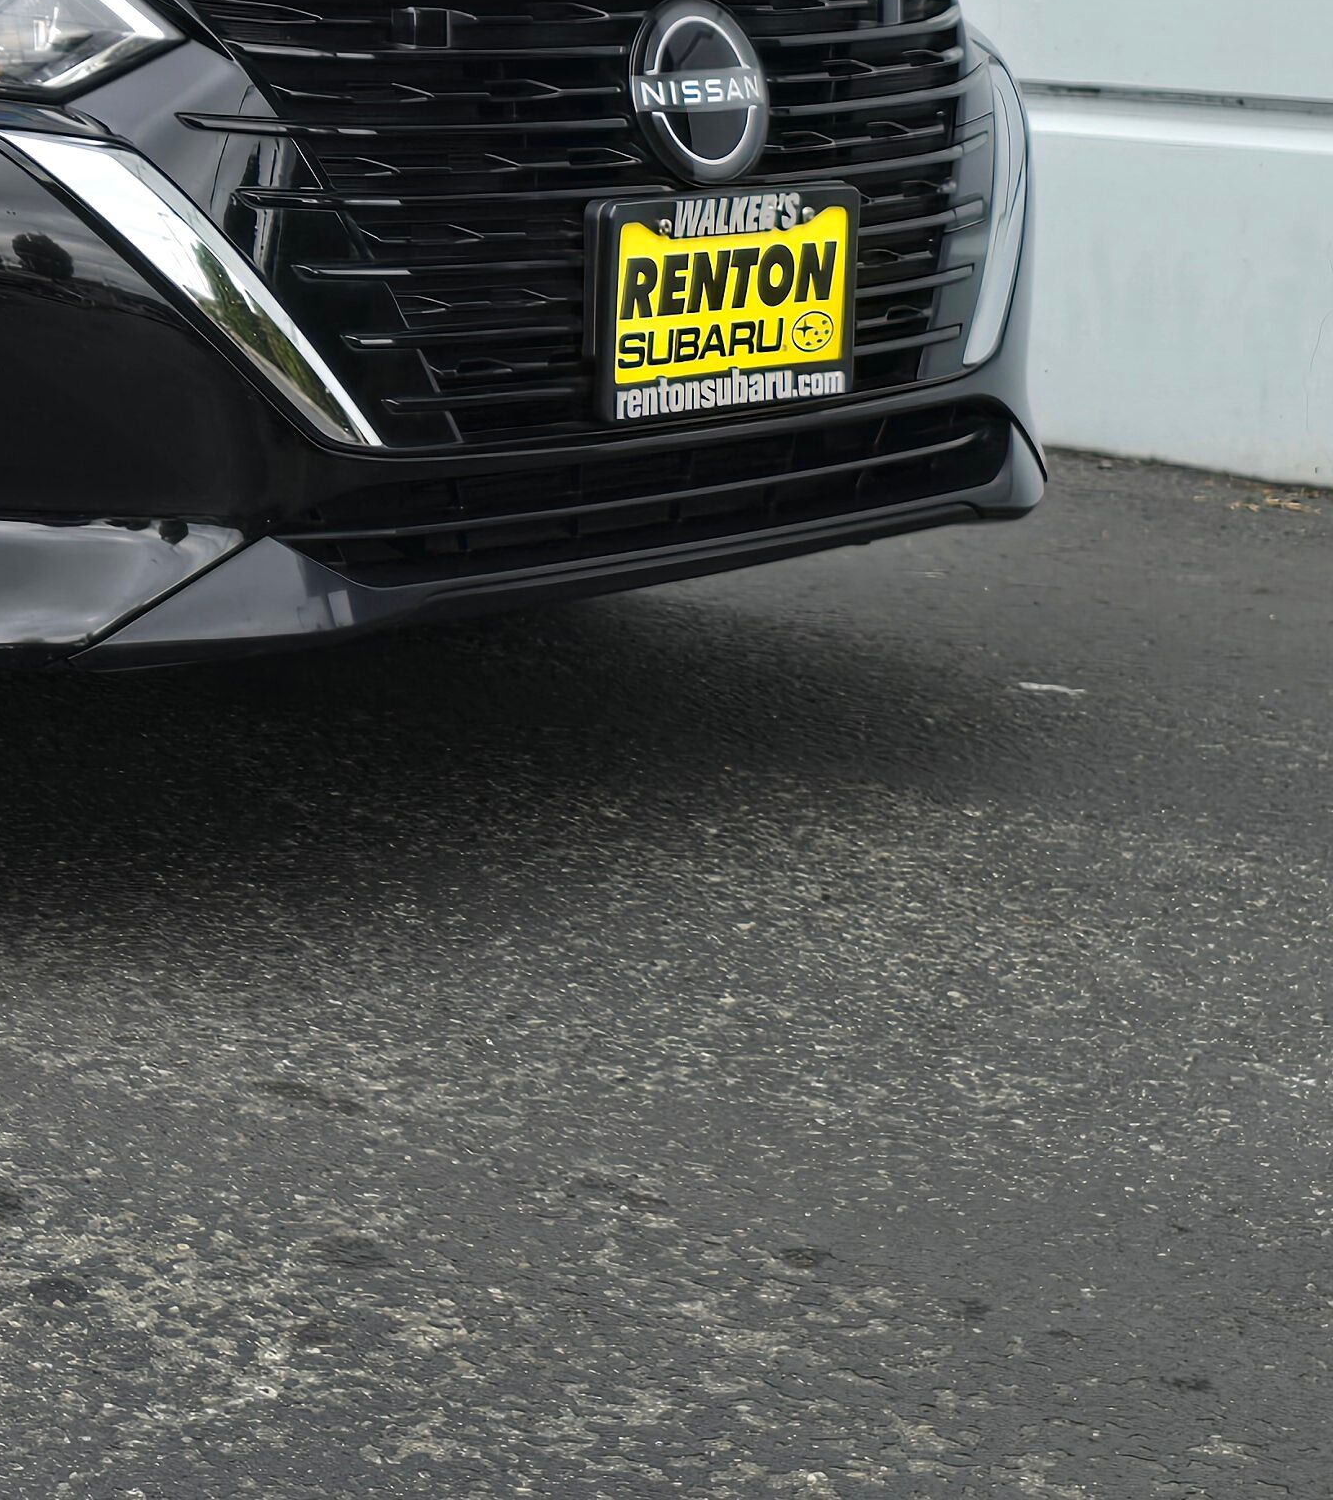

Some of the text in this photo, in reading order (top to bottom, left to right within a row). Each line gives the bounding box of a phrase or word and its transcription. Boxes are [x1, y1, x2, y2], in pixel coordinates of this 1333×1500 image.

[640, 75, 760, 106] NISSAN
[620, 241, 837, 320] RENTON
[618, 318, 784, 369] SUBARU
[616, 367, 845, 420] rentonsubaru.com
